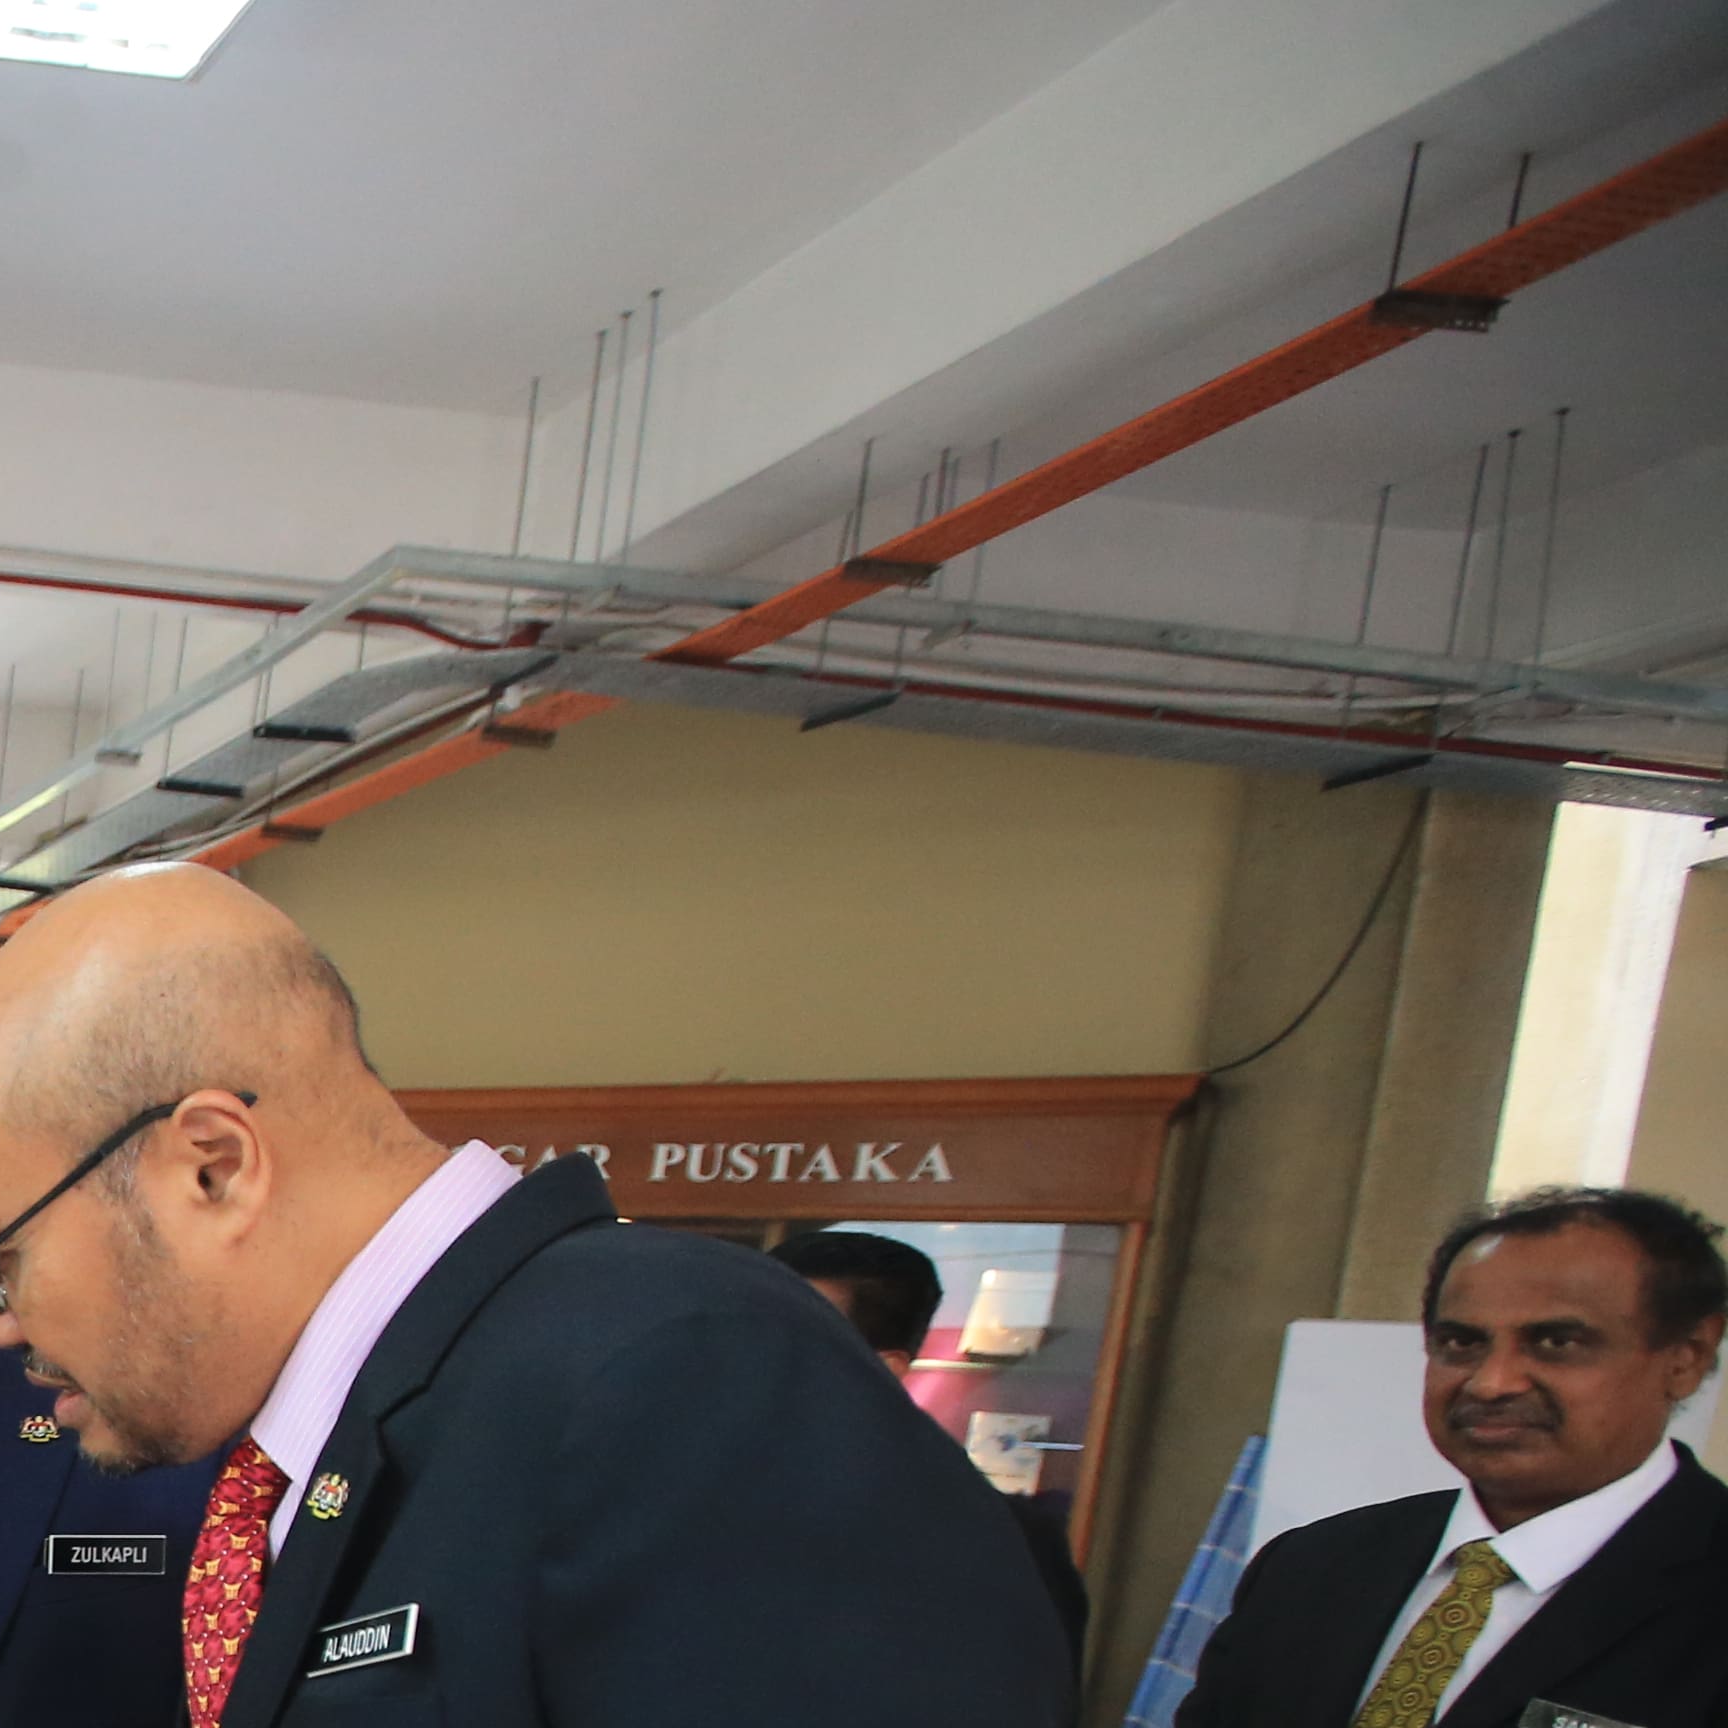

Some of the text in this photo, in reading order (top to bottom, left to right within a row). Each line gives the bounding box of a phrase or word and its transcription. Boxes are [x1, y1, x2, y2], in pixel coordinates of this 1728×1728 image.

[649, 1141, 953, 1183] PUSTAKA
[71, 1546, 147, 1565] ZULKAPLI
[323, 1623, 390, 1663] ALAUDDIN
